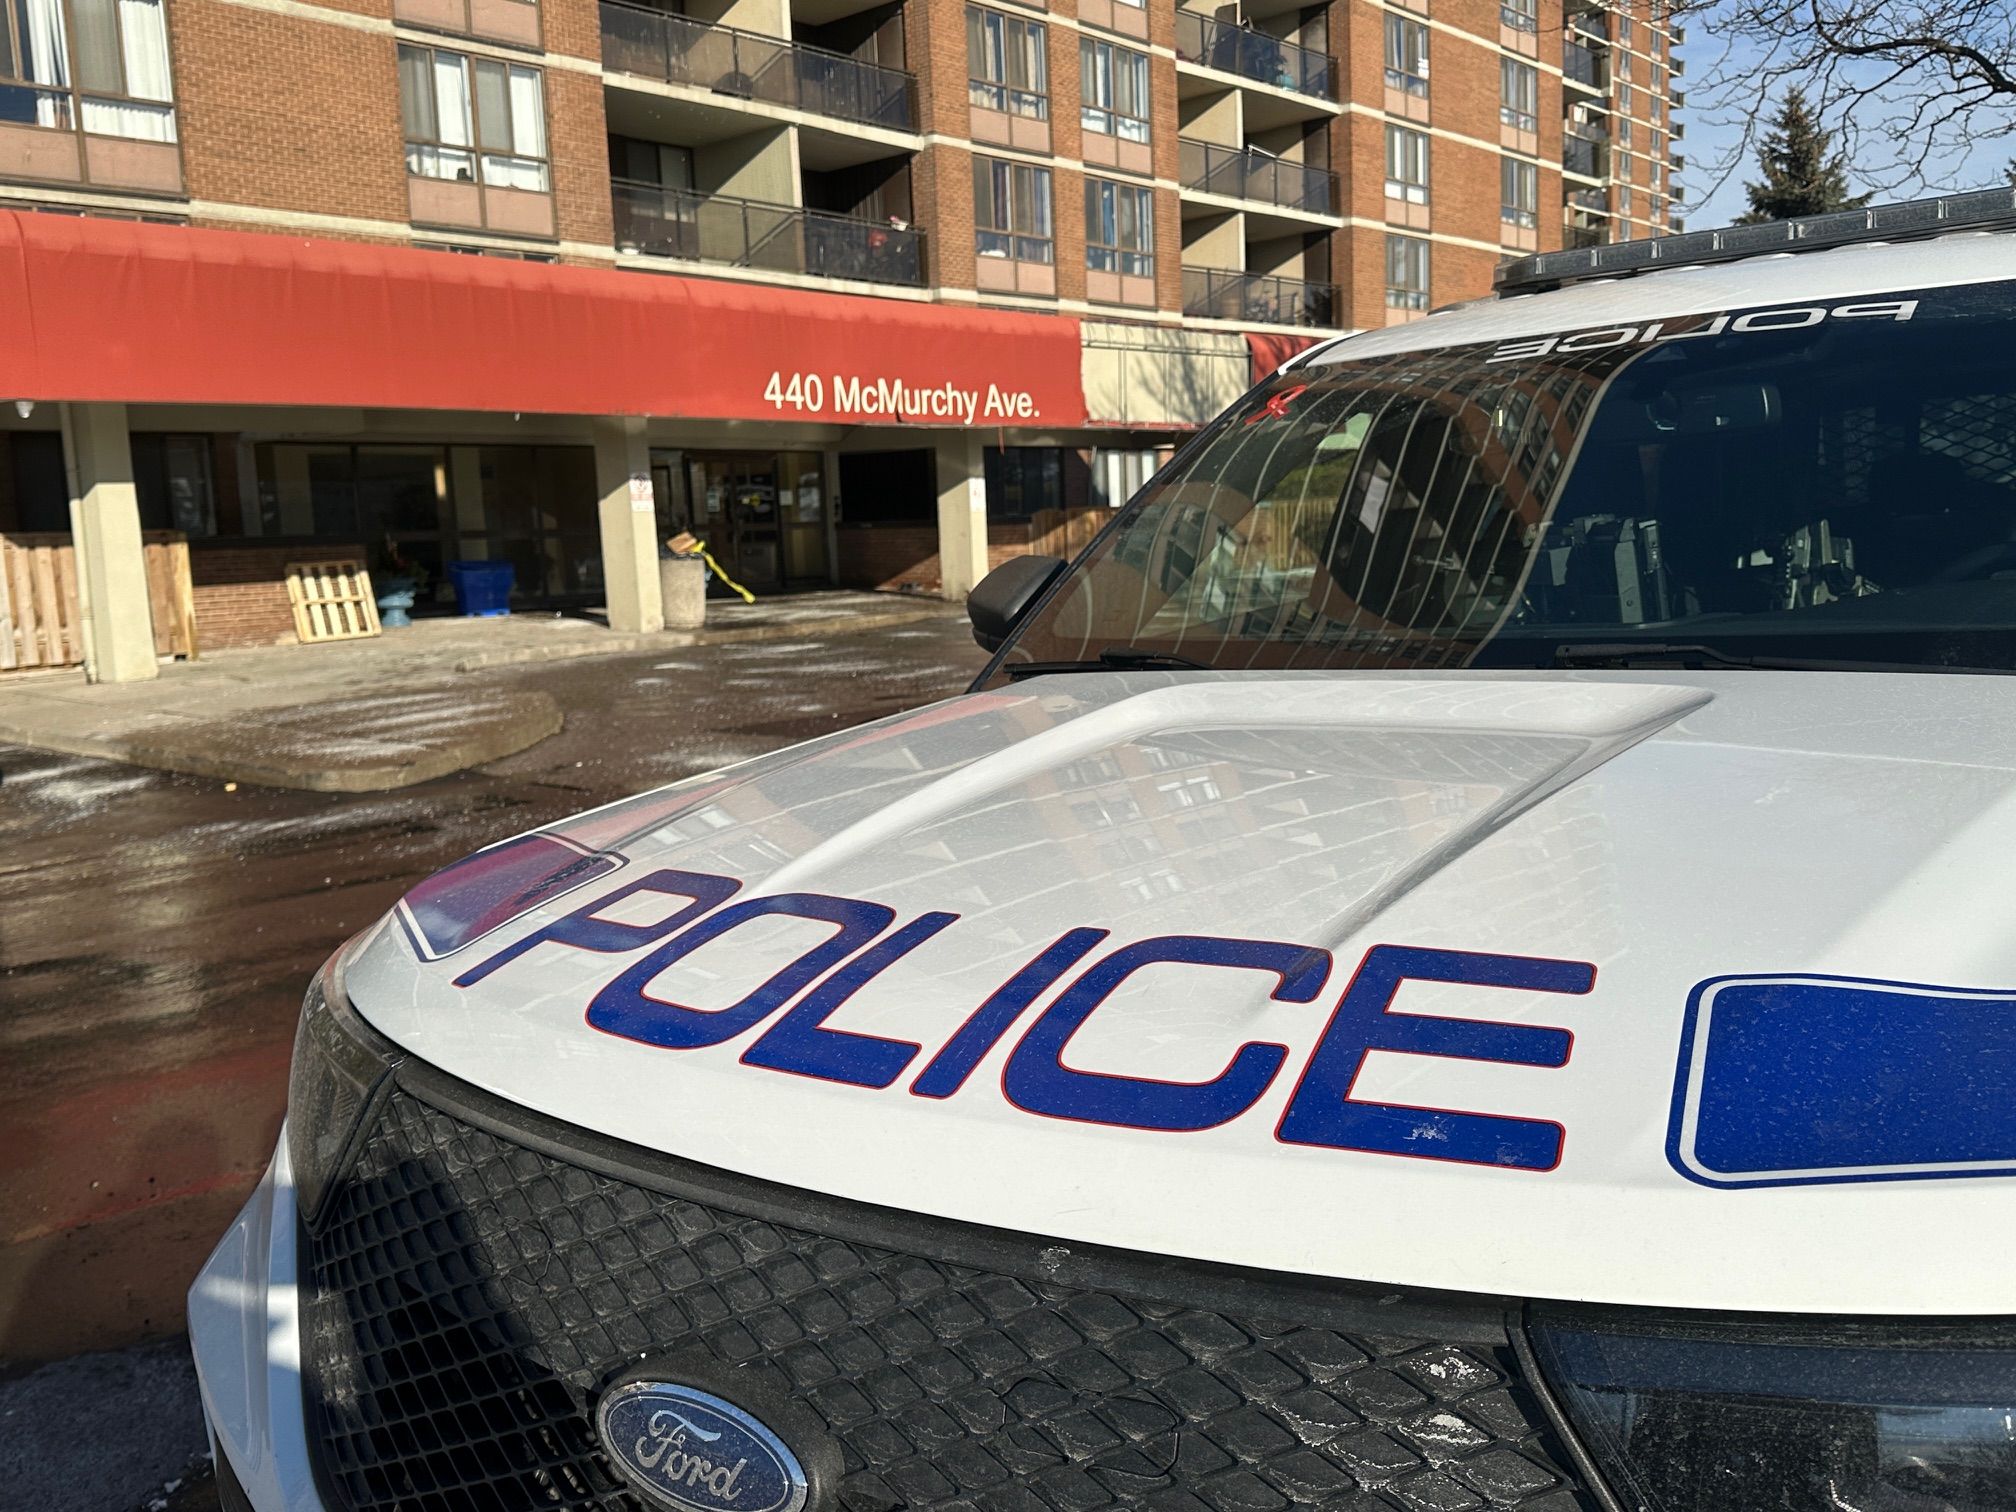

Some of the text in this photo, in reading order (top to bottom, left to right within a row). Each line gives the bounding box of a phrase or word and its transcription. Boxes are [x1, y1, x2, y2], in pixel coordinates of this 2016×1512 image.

[763, 370, 1041, 425] 440 McMurchy Ave.
[451, 868, 1598, 1173] POLICE
[634, 1409, 749, 1501] Ford
